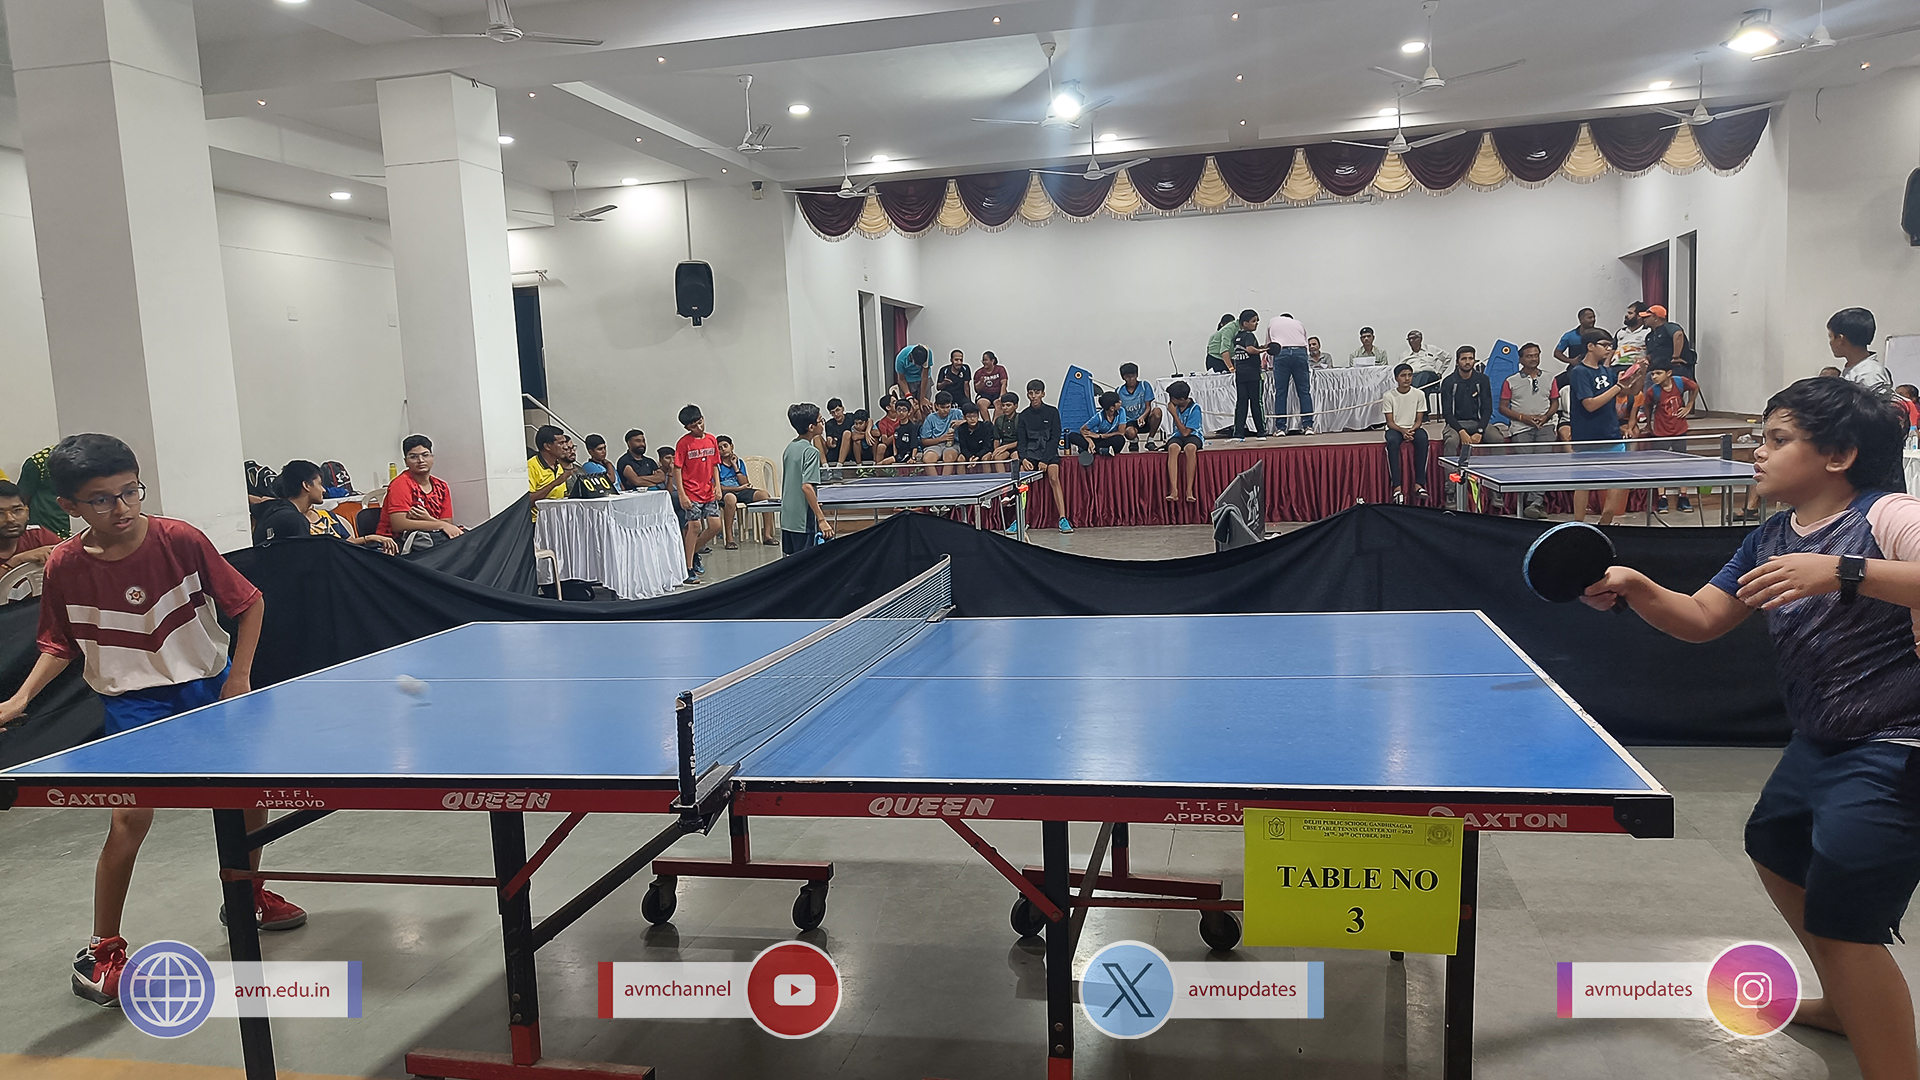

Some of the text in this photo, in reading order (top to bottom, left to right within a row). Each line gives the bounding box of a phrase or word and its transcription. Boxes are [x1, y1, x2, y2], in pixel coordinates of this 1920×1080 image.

[255, 800, 326, 808] APPROVD
[441, 791, 552, 810] QUEEN
[868, 796, 995, 817] QUEEN
[1276, 866, 1440, 892] TABLE NO
[1345, 906, 1366, 934] 3
